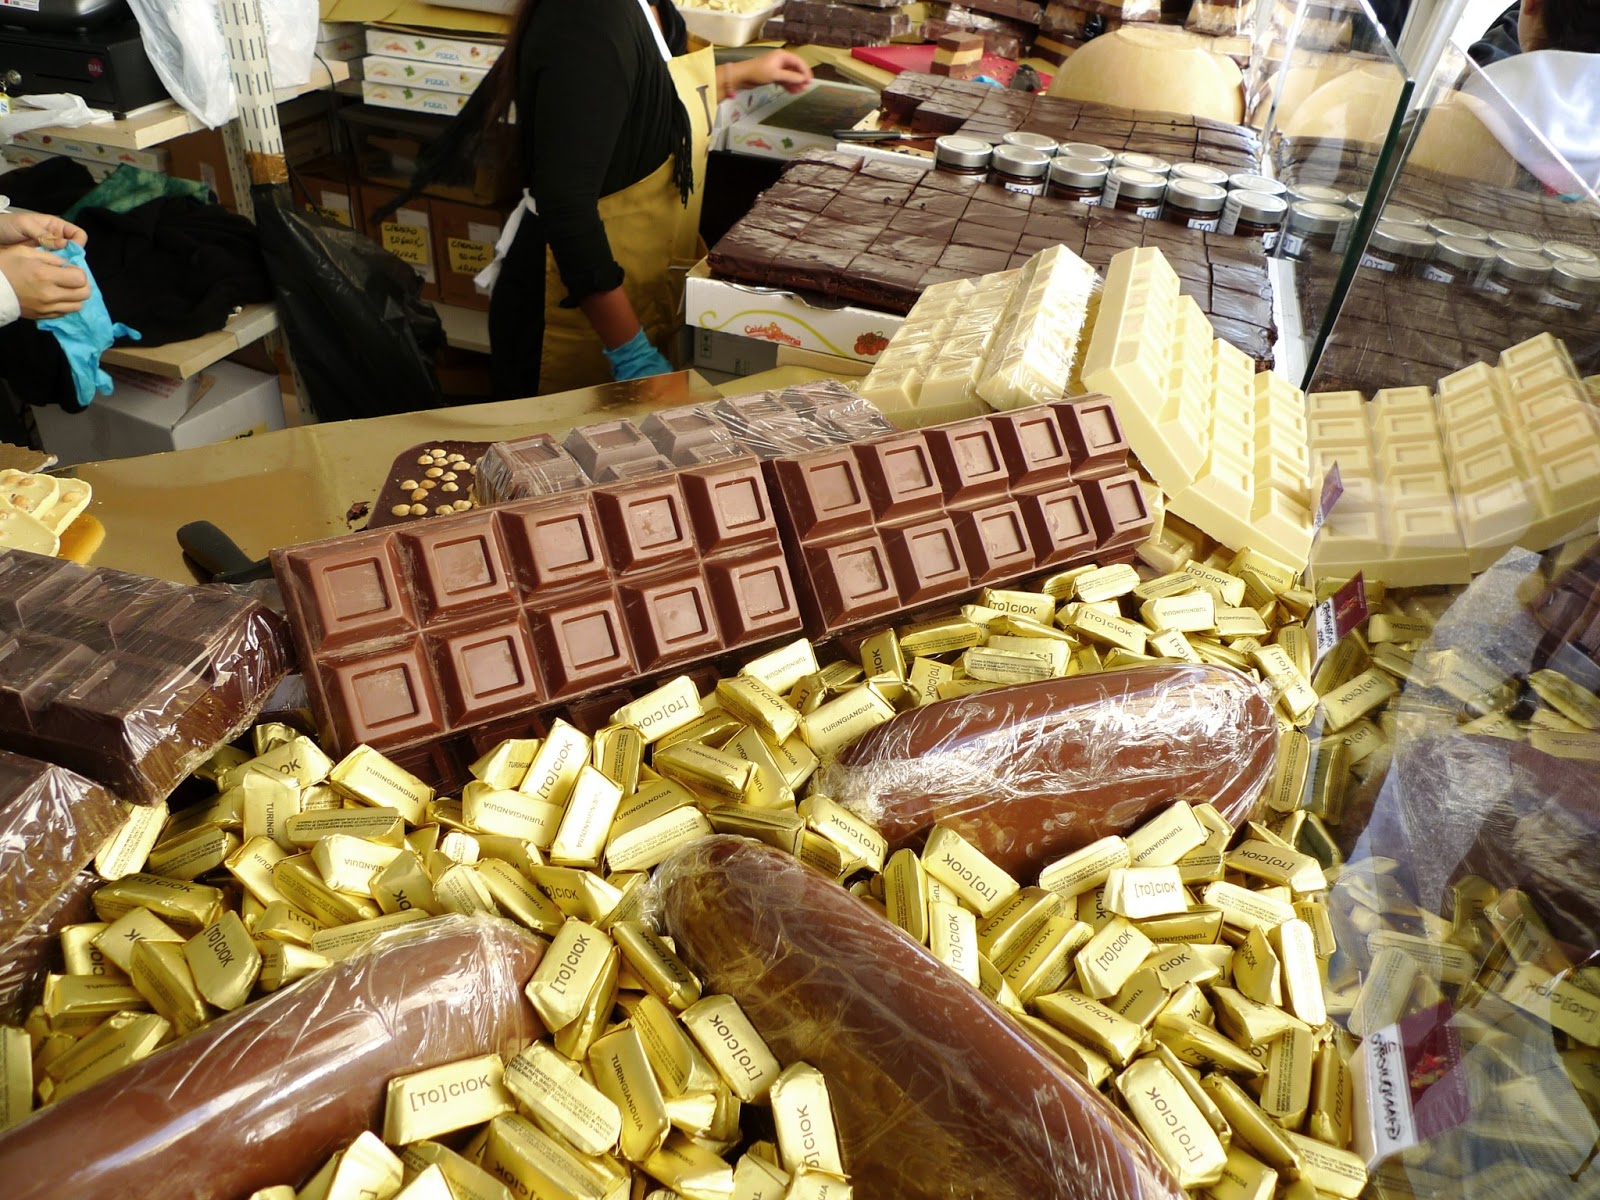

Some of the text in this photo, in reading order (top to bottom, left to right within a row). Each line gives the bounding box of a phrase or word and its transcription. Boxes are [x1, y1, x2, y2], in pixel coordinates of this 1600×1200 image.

[874, 648, 884, 679] CIOK
[821, 701, 875, 735] TURINGIANDUIA
[365, 766, 419, 803] TURINGIANDUIA
[484, 801, 545, 826] TURINGIANDUIA
[613, 789, 672, 823] TURINGIANDUIA
[1134, 826, 1183, 862] TURINGIANDUIA
[344, 858, 385, 873] GIANDUIA
[941, 853, 999, 902] [TO]CIOK
[1096, 890, 1107, 920] CIOK
[549, 934, 590, 995] [TO]CIOK
[1159, 953, 1191, 972] CIOK
[708, 1013, 763, 1082] [TO]CIOK
[409, 1074, 491, 1112] [TO]CIOK
[611, 1054, 643, 1132] TURINGIANDUIA
[1145, 1086, 1204, 1163] [TO]CIOK
